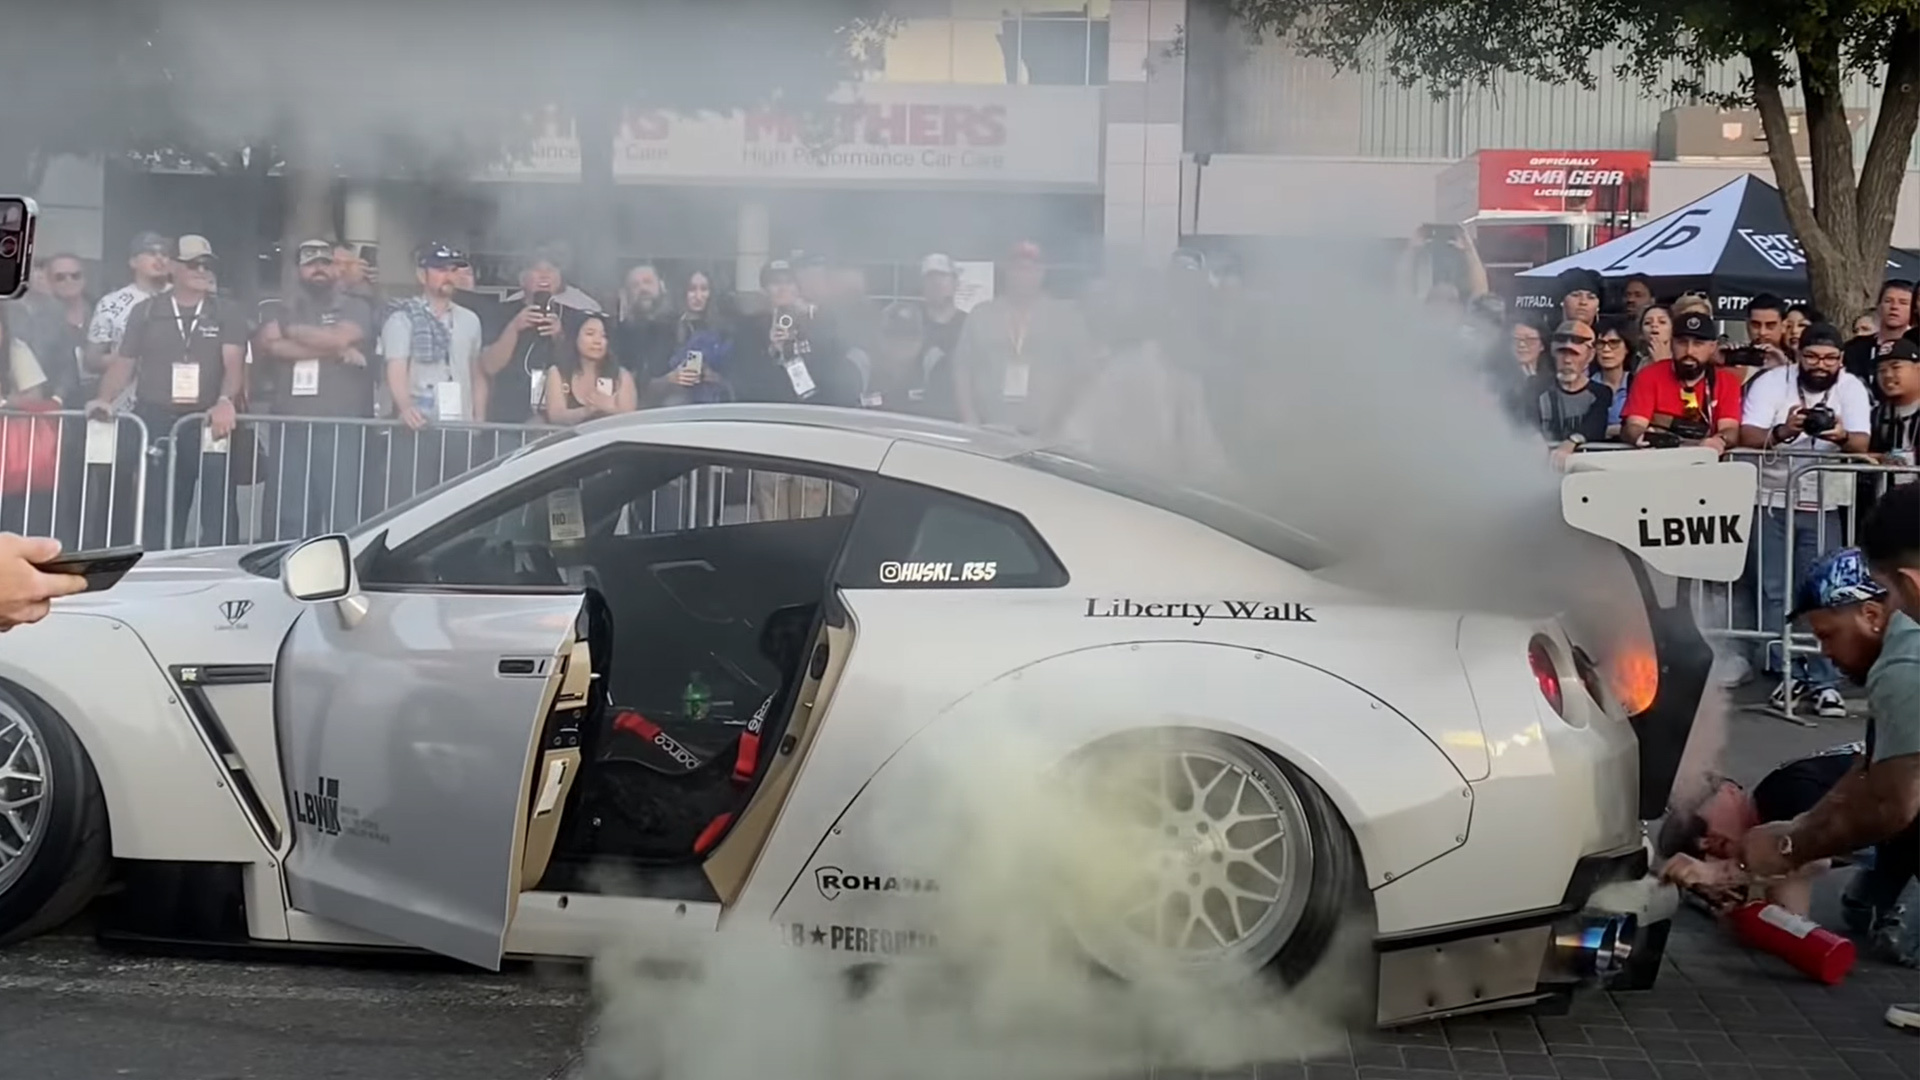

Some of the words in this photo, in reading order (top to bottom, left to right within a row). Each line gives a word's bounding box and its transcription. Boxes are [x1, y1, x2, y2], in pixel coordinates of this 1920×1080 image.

[744, 102, 1008, 147] MTHERS
[793, 148, 915, 169] Pormance
[1529, 157, 1599, 167] OFFICIALLY
[1505, 169, 1567, 185] SEMA
[1568, 169, 1625, 186] GEAR
[1534, 188, 1594, 197] LICENSED
[1638, 514, 1744, 548] LBWK
[900, 562, 997, 582] HUSKI_R35
[1084, 598, 1212, 626] Liberty
[1222, 600, 1318, 623] Walk
[654, 731, 702, 770] parco
